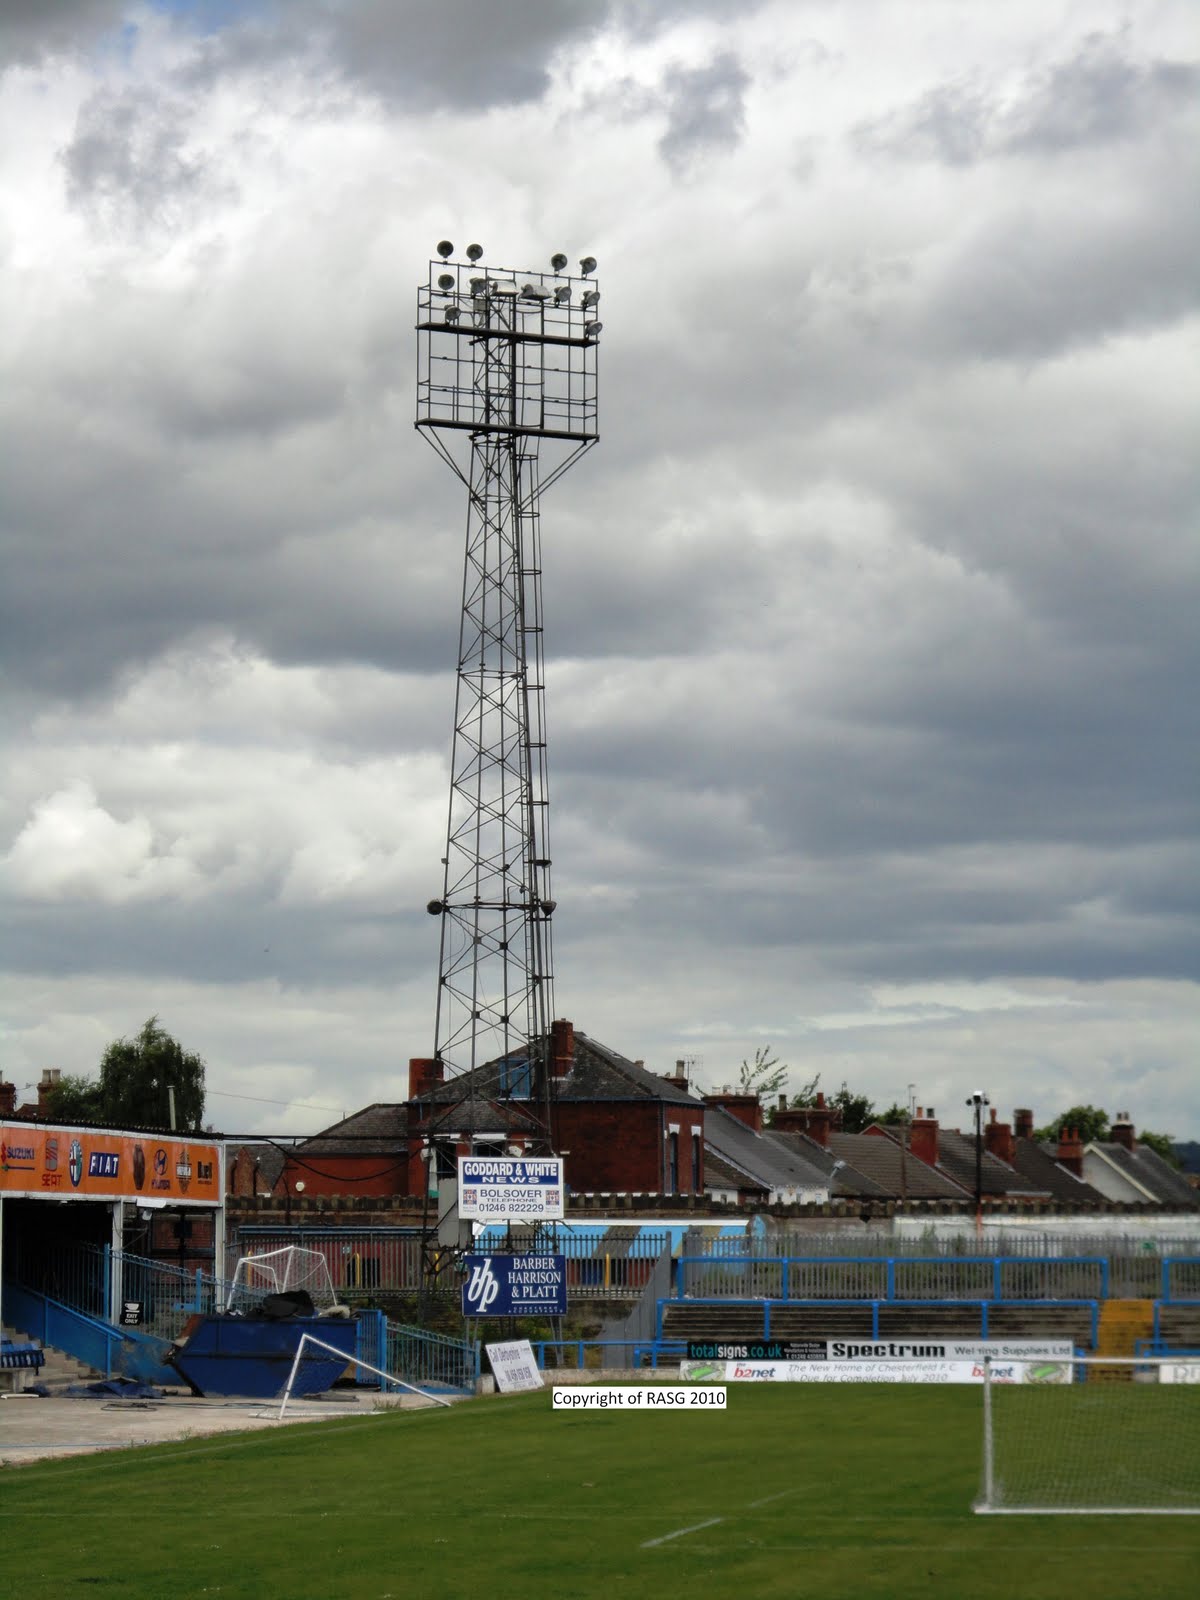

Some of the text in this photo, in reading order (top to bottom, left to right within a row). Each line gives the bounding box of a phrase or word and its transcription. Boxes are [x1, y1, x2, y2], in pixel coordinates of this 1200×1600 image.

[7, 1146, 35, 1160] SUZUKI
[89, 1155, 119, 1175] FIAT
[464, 1162, 557, 1177] GODDARD & WHITE
[41, 1173, 62, 1187] SEAT
[480, 1189, 542, 1198] BOLSOVER
[478, 1203, 506, 1213] 01246
[508, 1204, 544, 1213] 822229
[513, 1257, 556, 1270] BARBER
[508, 1271, 562, 1284] HARRISON
[511, 1286, 559, 1298] & PLATT
[690, 1343, 783, 1359] totalsigns.co.uk
[832, 1342, 946, 1359] Spectrum
[1052, 1345, 1071, 1355] Ltd
[733, 1367, 776, 1378] b2net
[788, 1364, 807, 1373] The
[809, 1364, 830, 1373] New
[833, 1364, 863, 1373] Home
[865, 1364, 876, 1373] of
[878, 1364, 937, 1373] Chesterfield
[800, 1374, 819, 1382] Due
[822, 1374, 837, 1382] for
[922, 1373, 948, 1383] 2010
